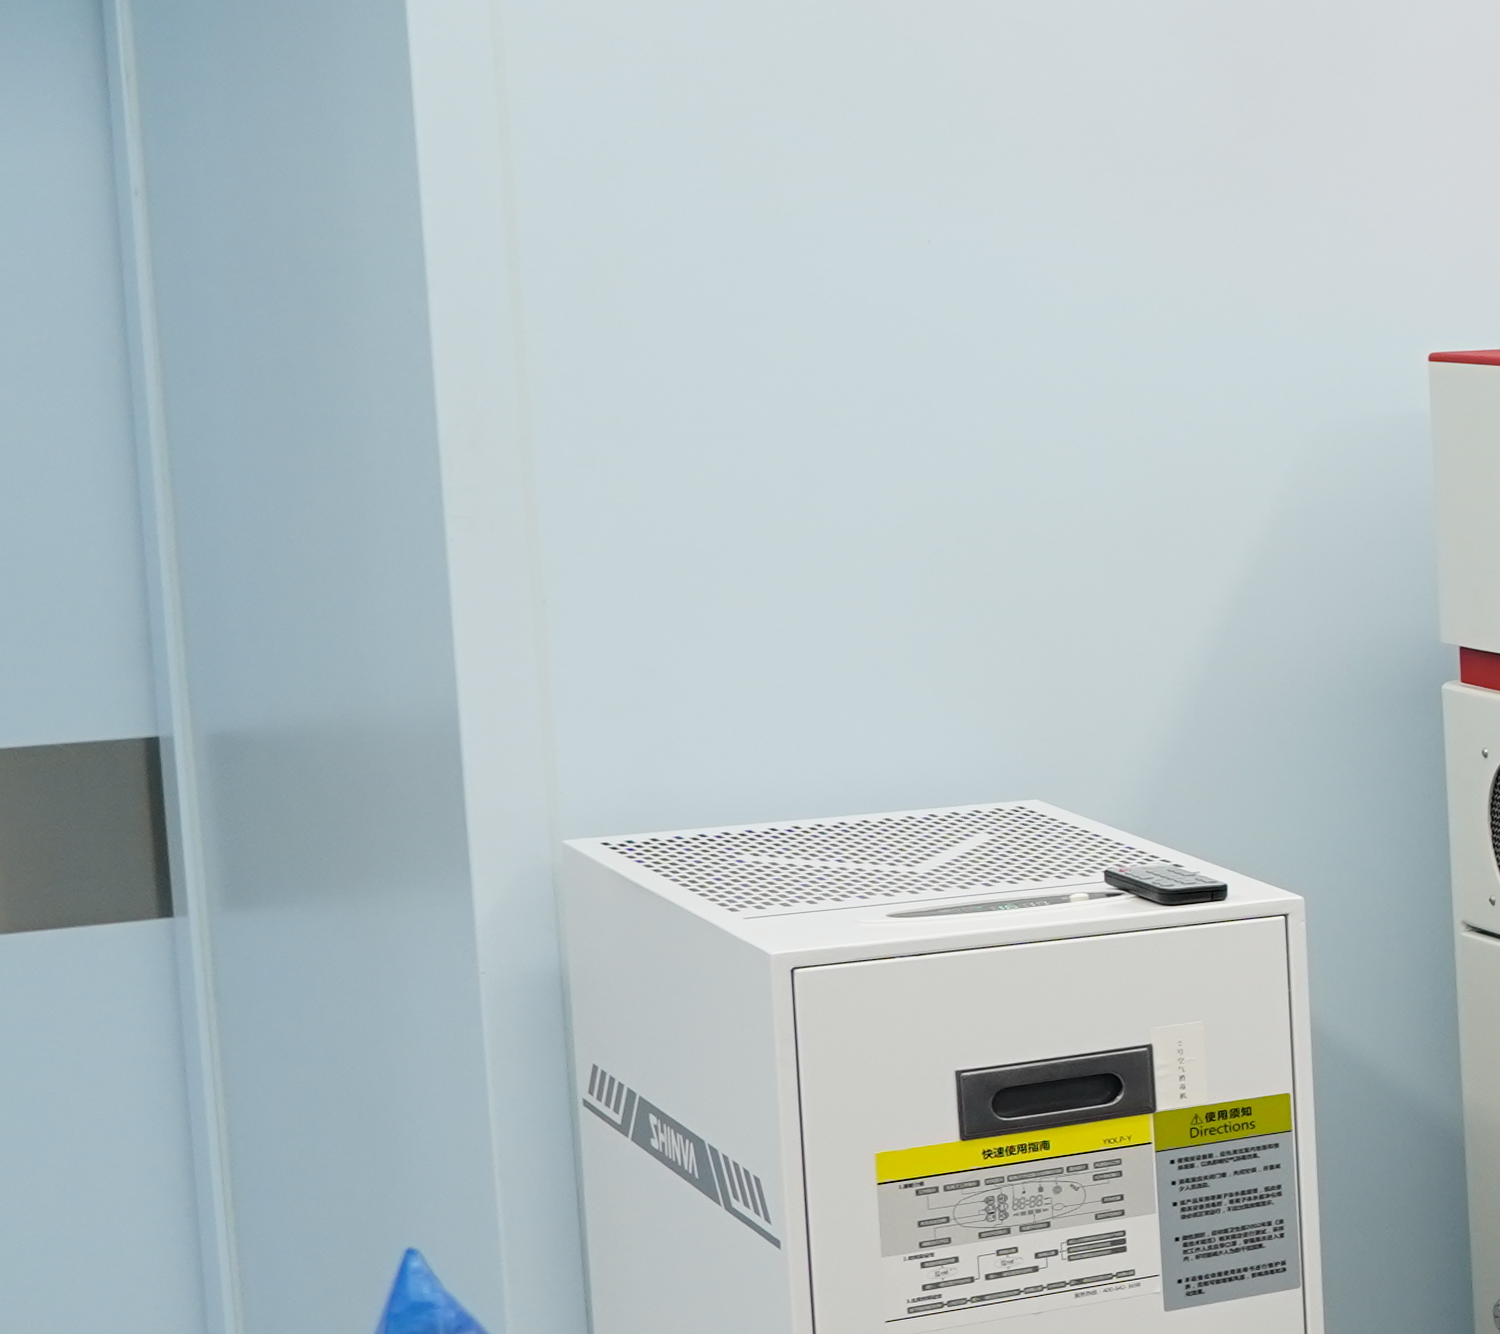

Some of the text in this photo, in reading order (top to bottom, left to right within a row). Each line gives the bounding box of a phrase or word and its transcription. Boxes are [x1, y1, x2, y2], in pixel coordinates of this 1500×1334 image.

[1205, 1106, 1253, 1122] 使用须知
[1190, 1120, 1256, 1138] Directions
[648, 1113, 700, 1179] SHINVA
[982, 1140, 1050, 1159] 快速使用指南
